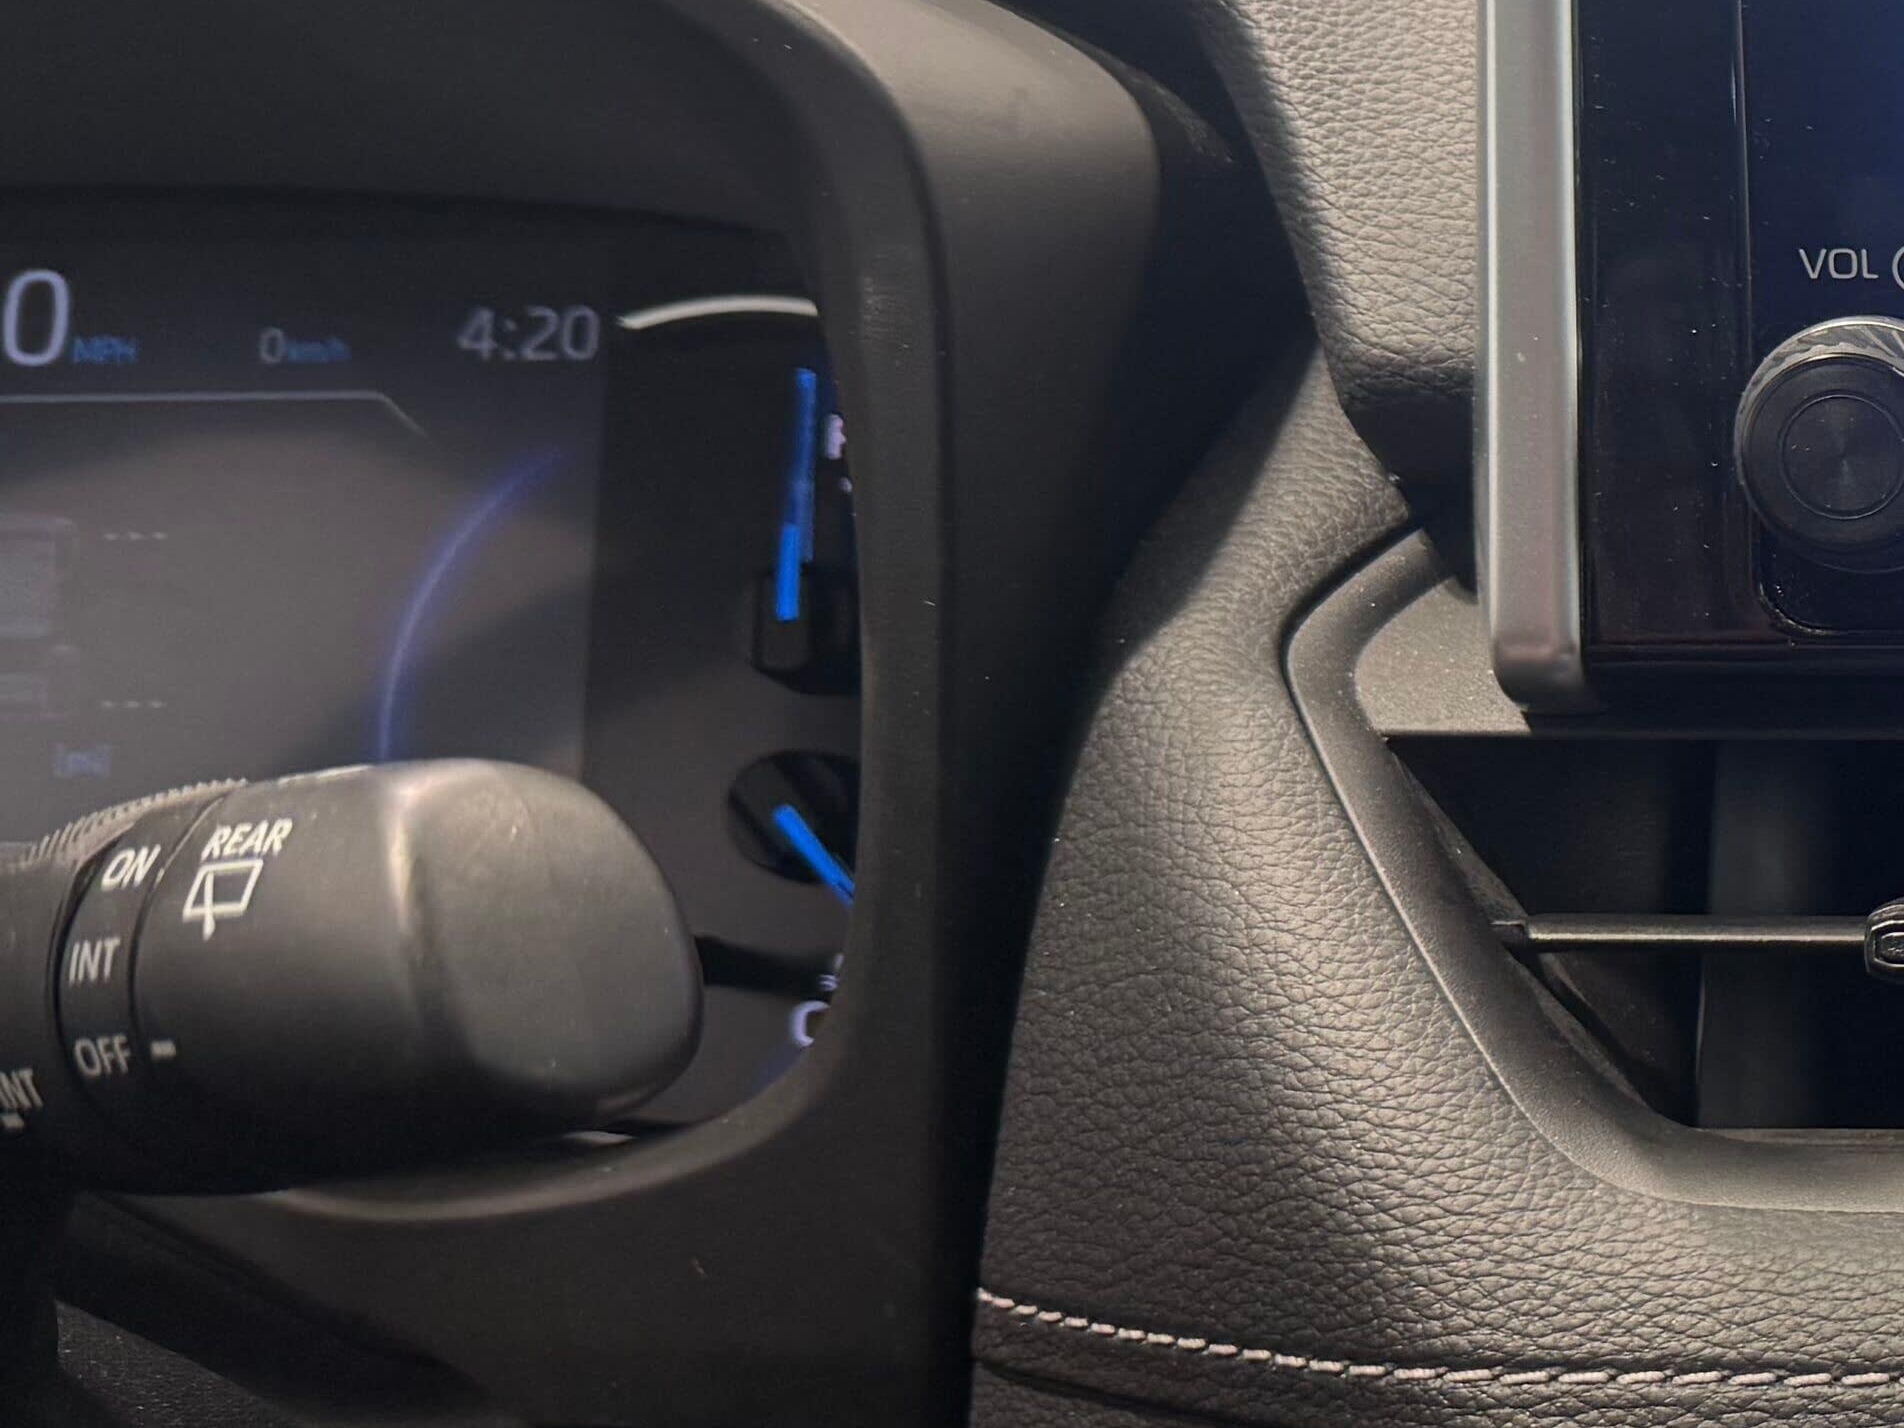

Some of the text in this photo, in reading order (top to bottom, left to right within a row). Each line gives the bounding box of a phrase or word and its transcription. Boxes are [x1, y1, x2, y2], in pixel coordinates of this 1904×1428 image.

[1798, 248, 1879, 279] VOL
[458, 306, 599, 361] 4:20
[200, 818, 293, 859] REAR
[101, 844, 162, 888] ON
[69, 936, 121, 981] INT
[74, 1035, 129, 1076] OFF
